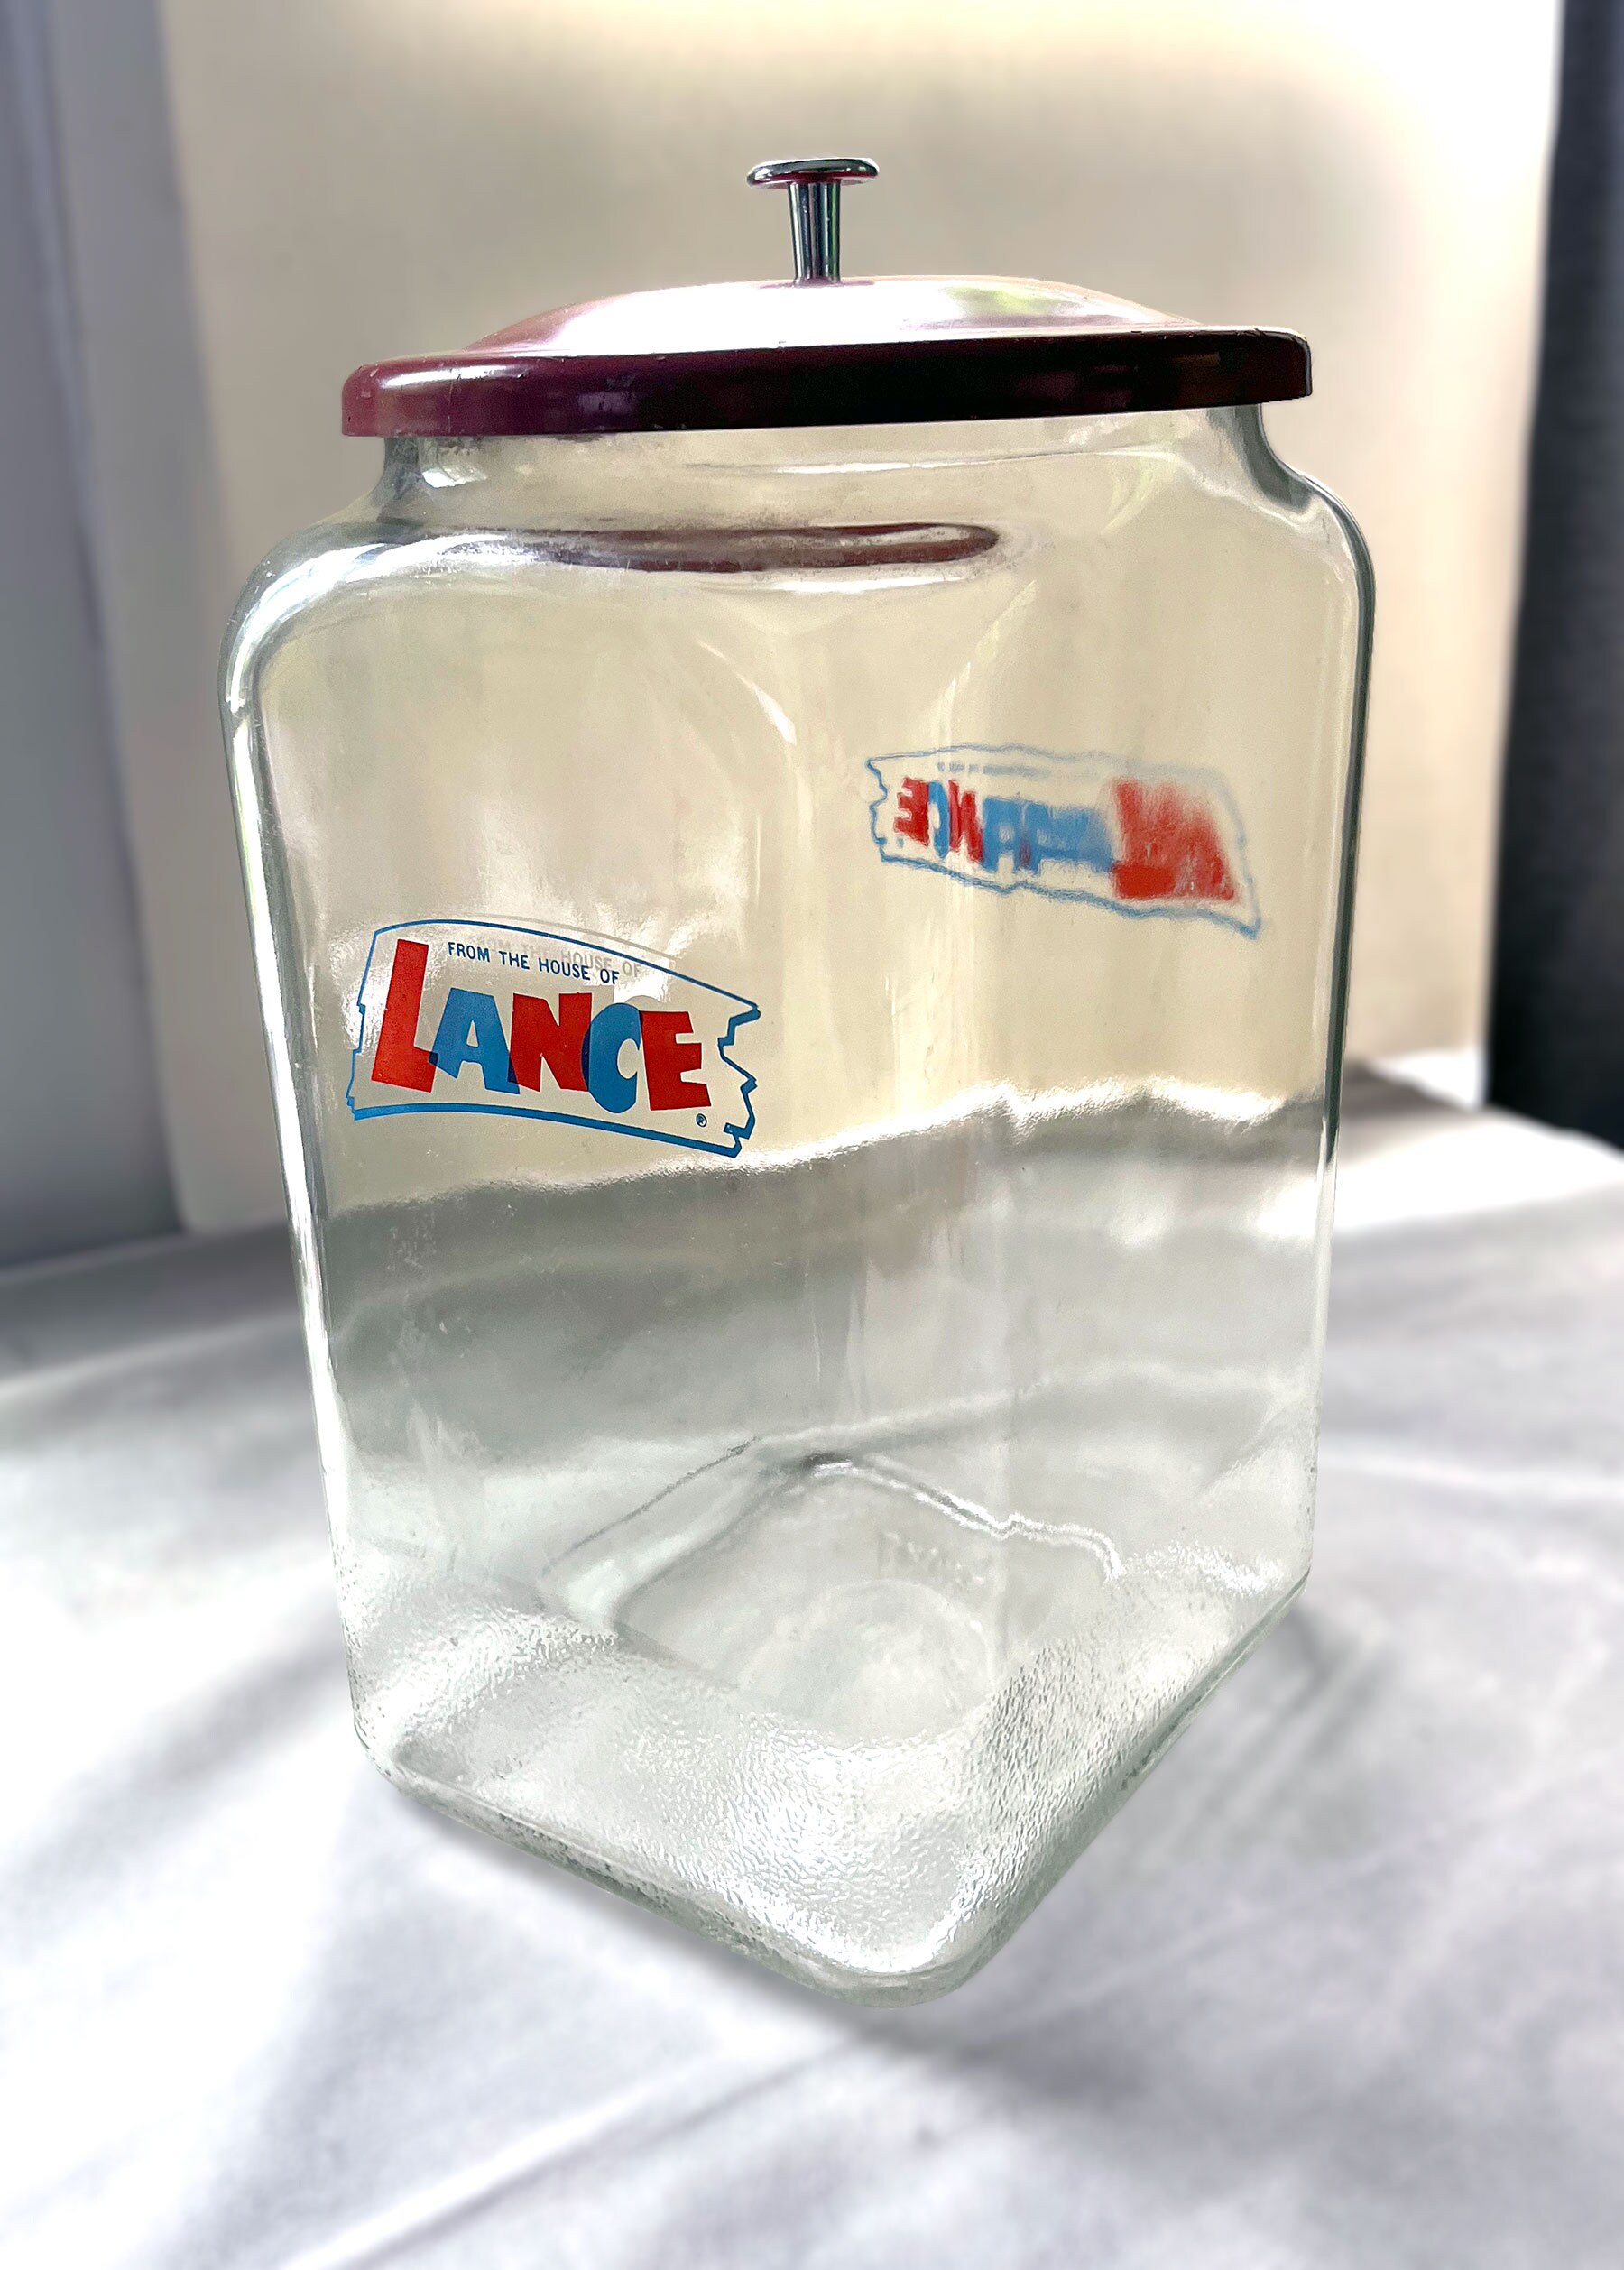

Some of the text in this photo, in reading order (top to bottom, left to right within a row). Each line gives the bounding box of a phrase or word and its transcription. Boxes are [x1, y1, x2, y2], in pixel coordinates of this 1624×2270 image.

[448, 942, 621, 985] FROM THE HOUSE OF
[371, 938, 712, 1114] LANCE
